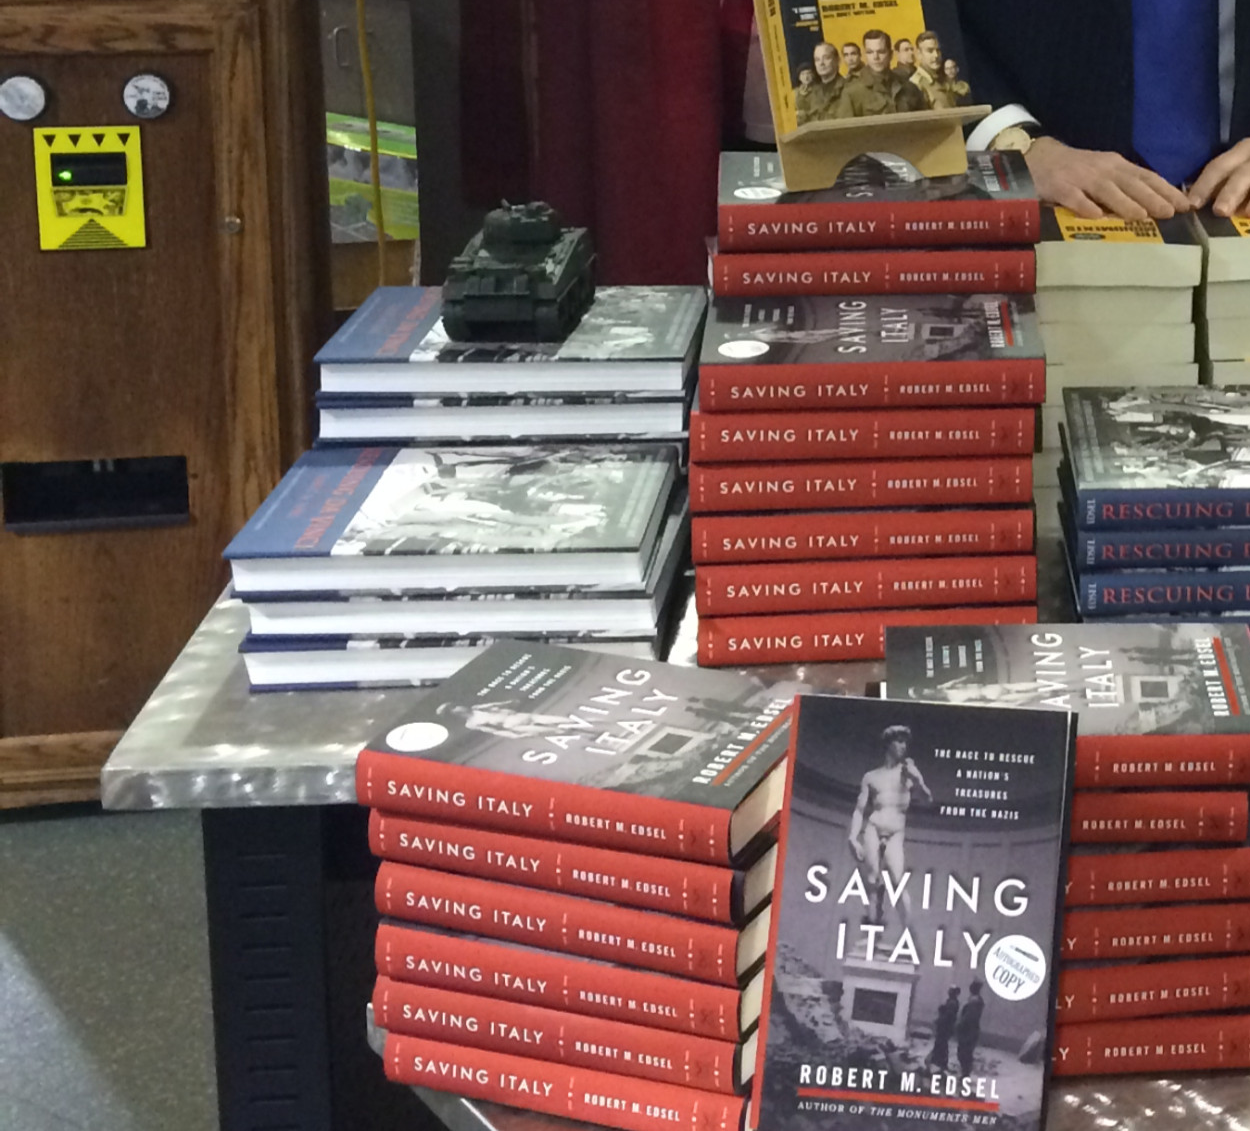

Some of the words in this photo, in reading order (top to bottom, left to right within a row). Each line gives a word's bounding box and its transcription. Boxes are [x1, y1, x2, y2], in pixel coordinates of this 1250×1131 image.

[748, 222, 818, 235] SAVING
[829, 222, 877, 233] ITALY
[743, 272, 813, 284] SAVING
[824, 272, 872, 283] ITALY
[838, 300, 867, 353] SAVING
[880, 308, 908, 342] ITALY
[731, 386, 806, 399] SAVING
[817, 385, 869, 397] ITALY
[721, 430, 796, 442] SAVING
[807, 429, 859, 441] ITALY
[720, 481, 795, 494] SAVING
[806, 479, 857, 491] ITALY
[1102, 502, 1234, 519] RESCUING
[723, 537, 797, 549] SAVING
[808, 536, 859, 548] ITALY
[1102, 542, 1233, 560] RESCUING
[727, 584, 801, 597] SAVING
[813, 582, 863, 594] ITALY
[1102, 586, 1235, 604] RESCUING
[728, 636, 803, 650] SAVING
[814, 635, 865, 647] ITALY
[1031, 633, 1072, 709] AVING
[1079, 646, 1119, 707] ITALY
[523, 669, 652, 765] SAVING
[584, 689, 679, 755] ITALY
[692, 744, 744, 784] ROBERT
[750, 699, 792, 728] EDSEL
[935, 749, 951, 758] THE
[956, 750, 979, 760] RACE
[984, 752, 994, 761] TO
[999, 753, 1035, 764] RESCUE
[956, 769, 962, 777] A
[387, 780, 466, 806] SAVING
[478, 797, 533, 818] ITALY
[955, 788, 1007, 800] TREASURES
[566, 813, 611, 829] ROBERT
[631, 823, 667, 840] EDSEL
[940, 806, 965, 816] FROM
[971, 808, 986, 818] THE
[991, 810, 1019, 820] NAZIS
[1082, 819, 1127, 829] ROBERT
[1148, 819, 1186, 829] EDSEL
[400, 833, 475, 860] SAVING
[487, 850, 540, 873] ITALY
[804, 865, 1029, 917] SAVING
[406, 893, 482, 920] SAVING
[494, 909, 546, 932] ITALY
[835, 922, 991, 969] ITALY
[406, 955, 483, 982] SAVING
[494, 972, 547, 994] ITALY
[993, 947, 1040, 984] AUTOGRAPHED
[993, 965, 1025, 994] COPY
[403, 1004, 479, 1032] SAVING
[490, 1022, 543, 1044] ITALY
[1104, 1047, 1149, 1056] ROBERT
[1170, 1044, 1206, 1054] EDSEL
[414, 1056, 489, 1084] SAVING
[500, 1074, 553, 1097] ITALY
[800, 1064, 888, 1090] ROBERT
[900, 1071, 921, 1093] M.
[931, 1074, 999, 1099] EDSEL
[584, 1093, 627, 1111] ROBERT
[646, 1104, 680, 1122] EDSEL
[798, 1101, 845, 1112] AUTHOR
[850, 1105, 865, 1115] OF
[870, 1106, 892, 1117] THE
[897, 1110, 968, 1123] MONUMENTS
[973, 1114, 997, 1124] MEN
